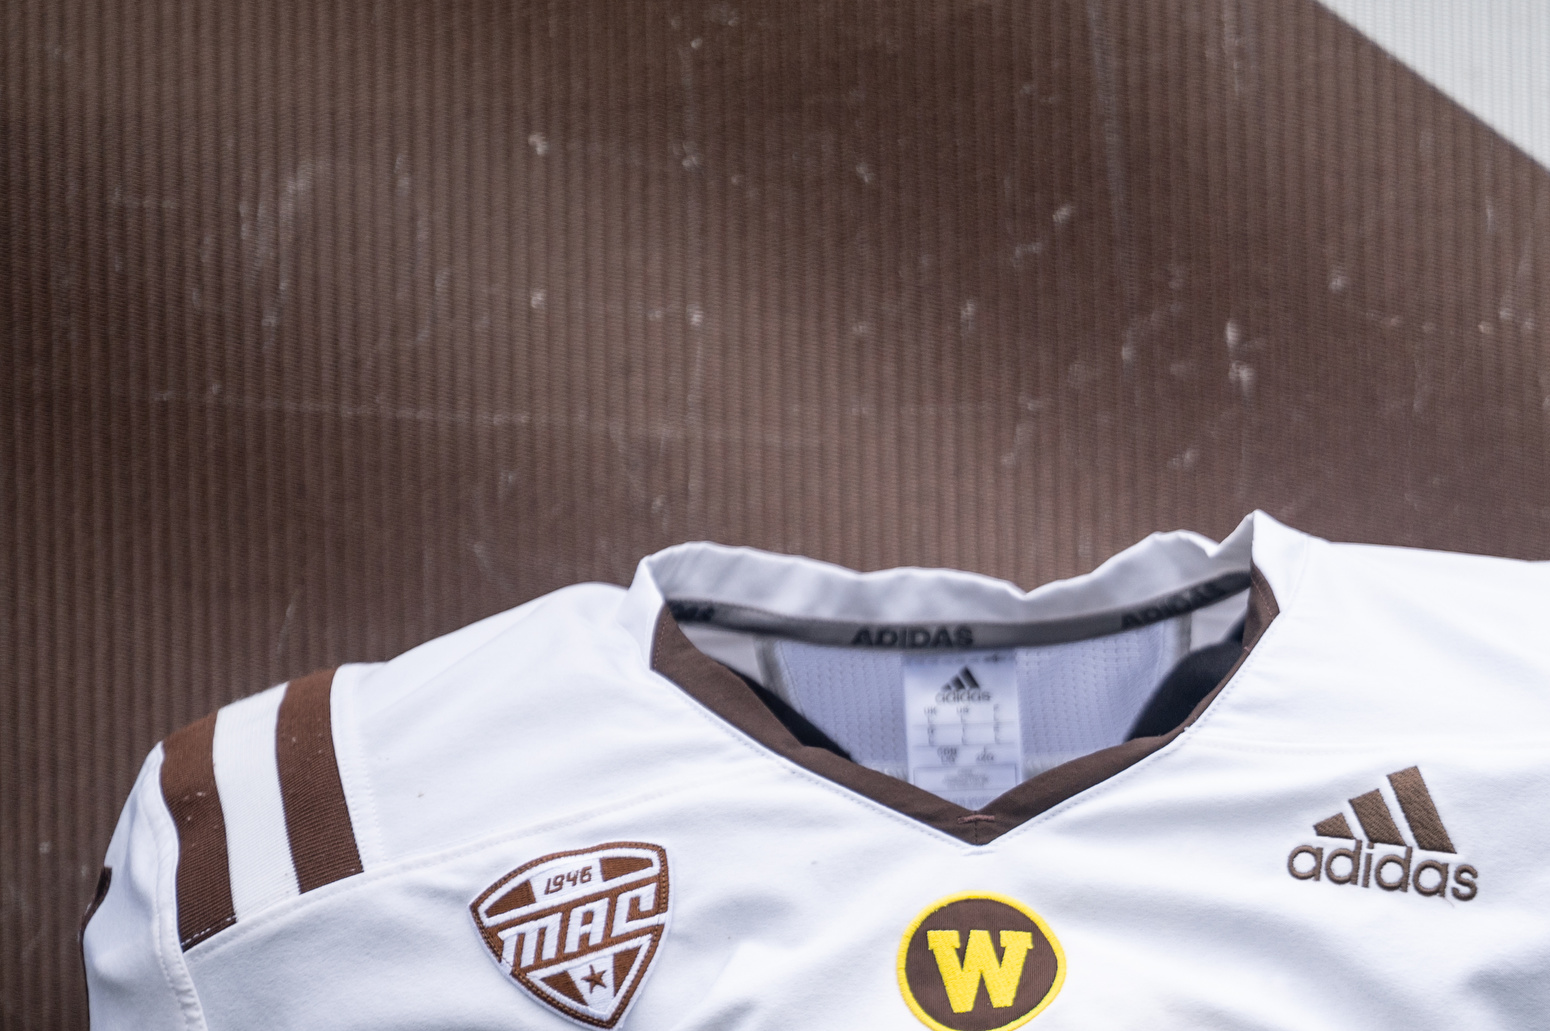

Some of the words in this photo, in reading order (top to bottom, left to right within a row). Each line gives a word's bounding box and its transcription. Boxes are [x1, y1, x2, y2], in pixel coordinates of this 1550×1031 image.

[850, 624, 974, 648] ADIDAS
[935, 688, 992, 703] adidas
[544, 865, 593, 896] 1946
[1287, 839, 1478, 901] adidas
[497, 882, 669, 970] MAC
[927, 929, 1033, 1014] W
